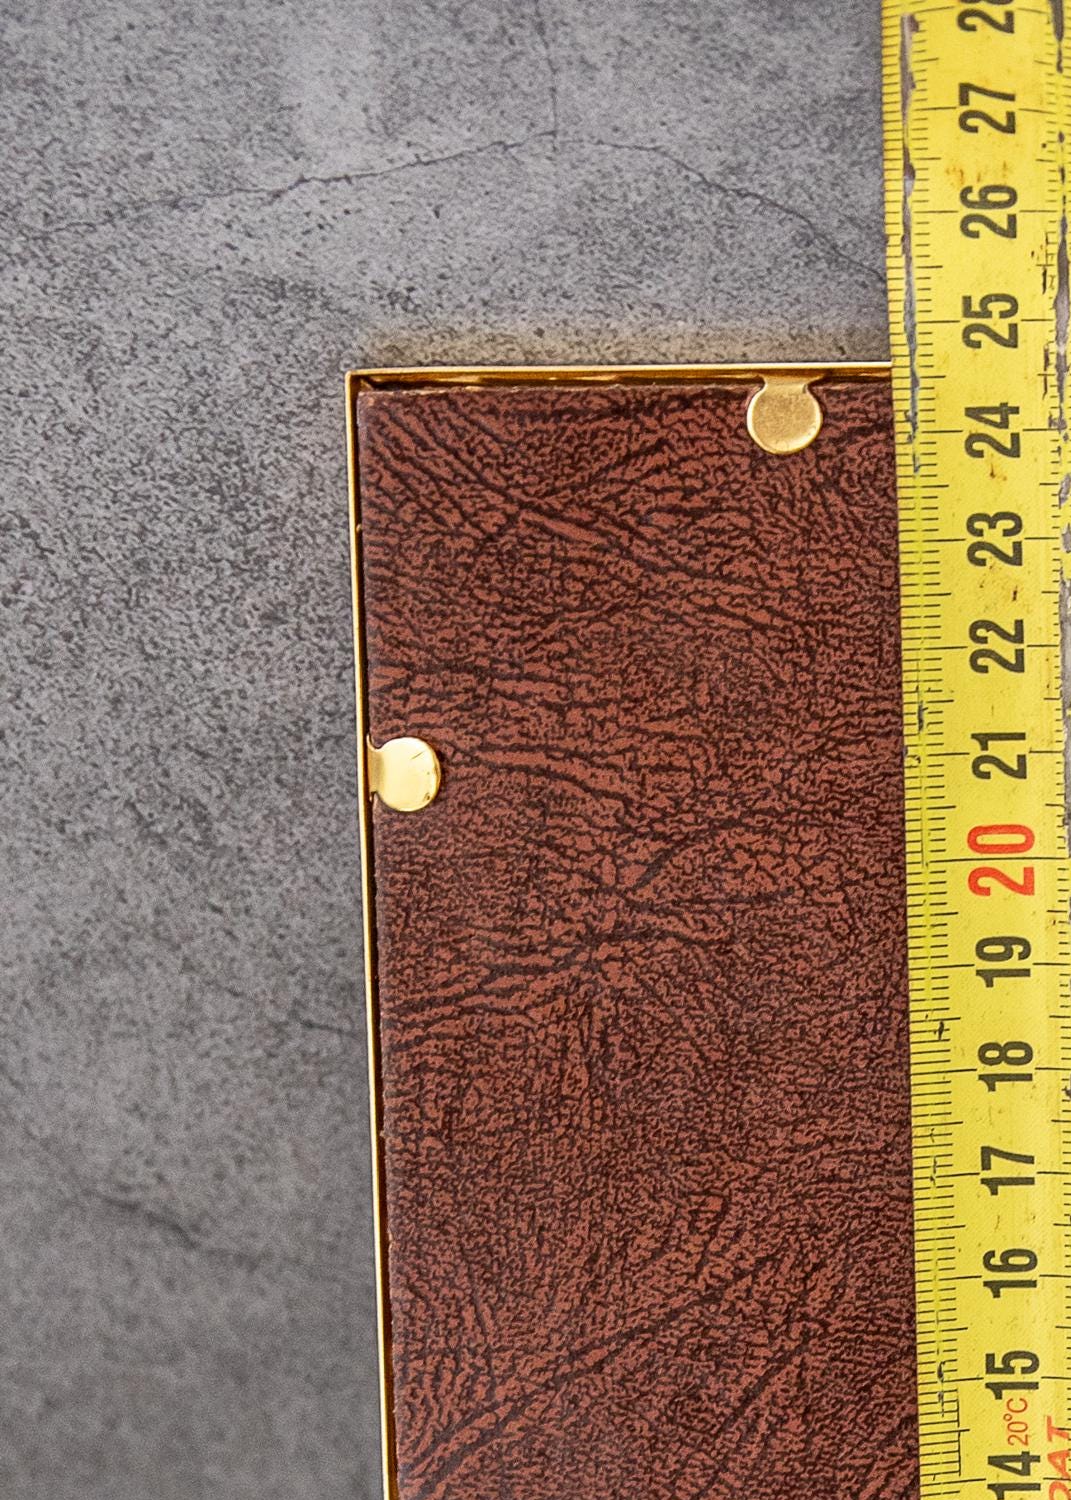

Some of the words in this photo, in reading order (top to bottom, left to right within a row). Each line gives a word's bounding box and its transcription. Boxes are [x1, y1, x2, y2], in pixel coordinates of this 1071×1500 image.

[957, 0, 1016, 35] 2
[958, 82, 1016, 134] 27
[959, 184, 1018, 239] 26
[961, 293, 1019, 350] 25
[964, 402, 1020, 458] 24
[966, 511, 1023, 567] 23
[968, 619, 1025, 674] 22
[970, 732, 1027, 780] 21
[967, 824, 1035, 897] 20
[975, 935, 1031, 988] 19
[977, 1041, 1033, 1092] 18
[980, 1145, 1035, 1196] 17
[983, 1248, 1038, 1299] 16
[985, 1350, 1039, 1400] 15
[1003, 1397, 1029, 1447] 20°C
[987, 1451, 1041, 1500] 14
